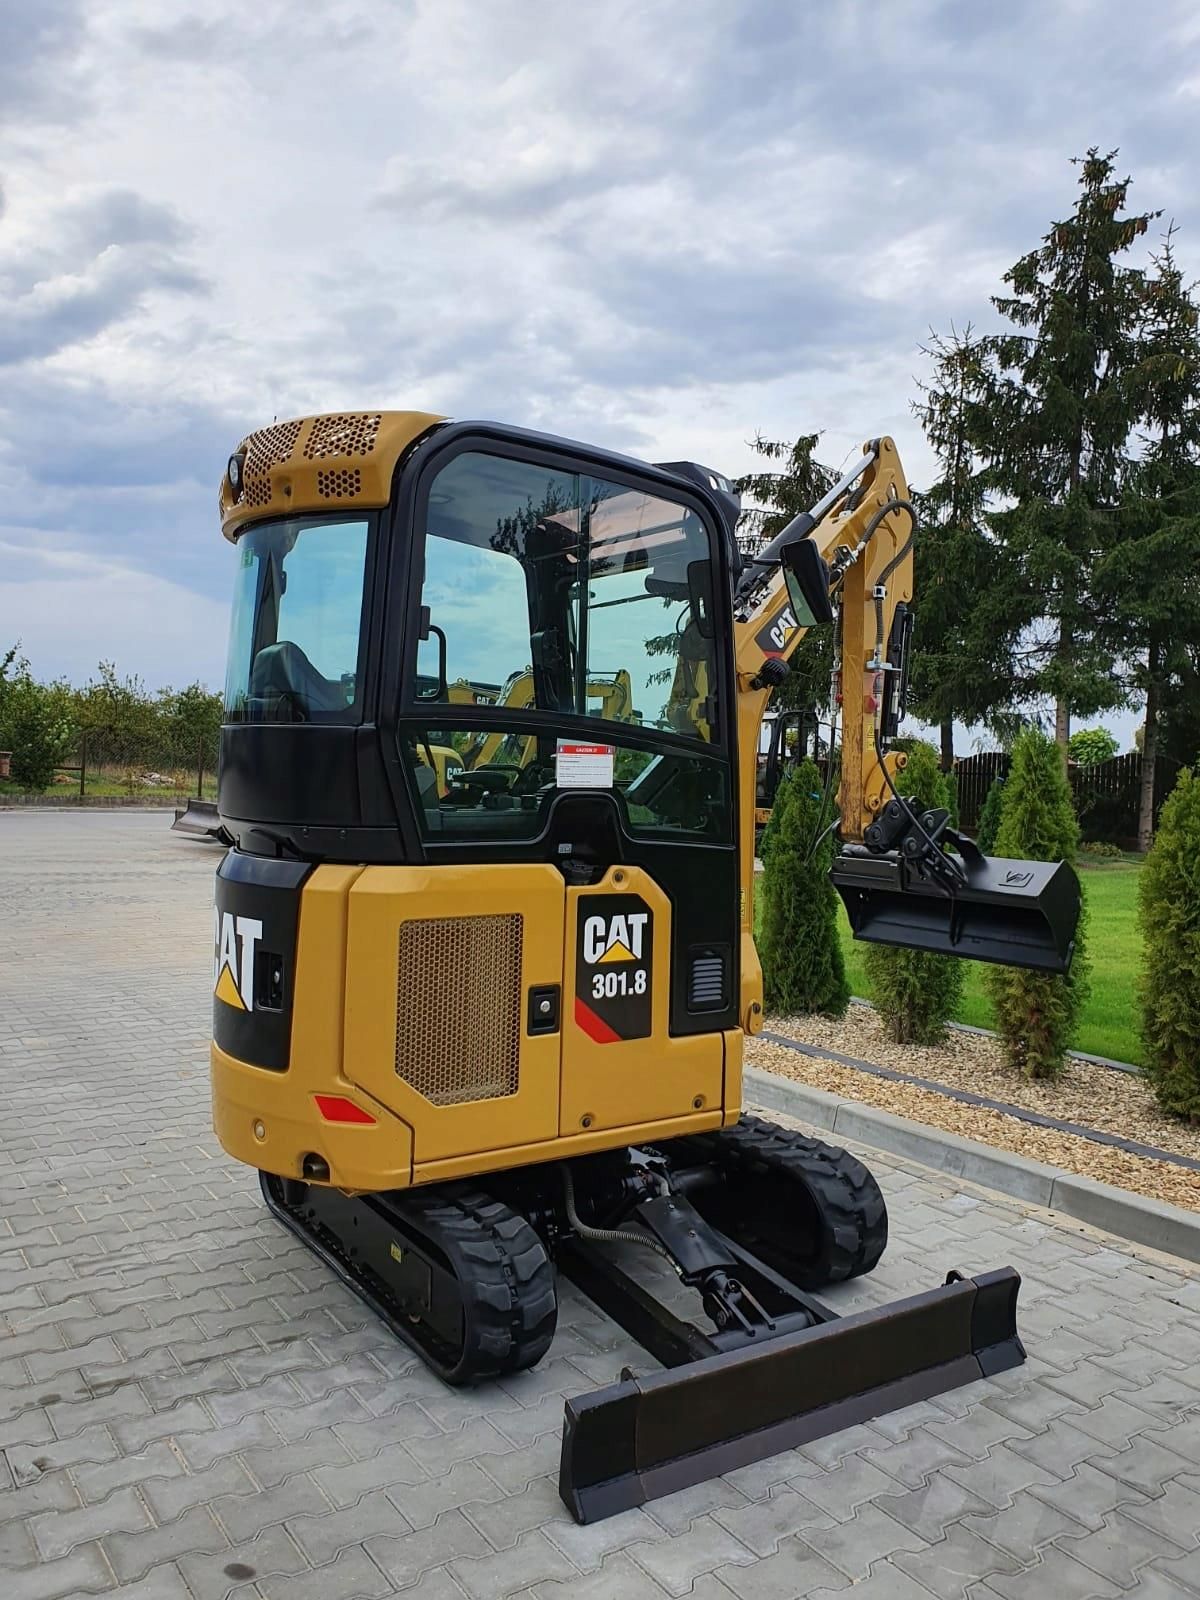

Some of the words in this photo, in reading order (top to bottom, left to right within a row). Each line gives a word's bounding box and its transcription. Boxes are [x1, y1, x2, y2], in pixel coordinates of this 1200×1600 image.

[770, 607, 798, 649] CAT
[583, 913, 648, 964] CAT
[592, 969, 647, 999] 301.8
